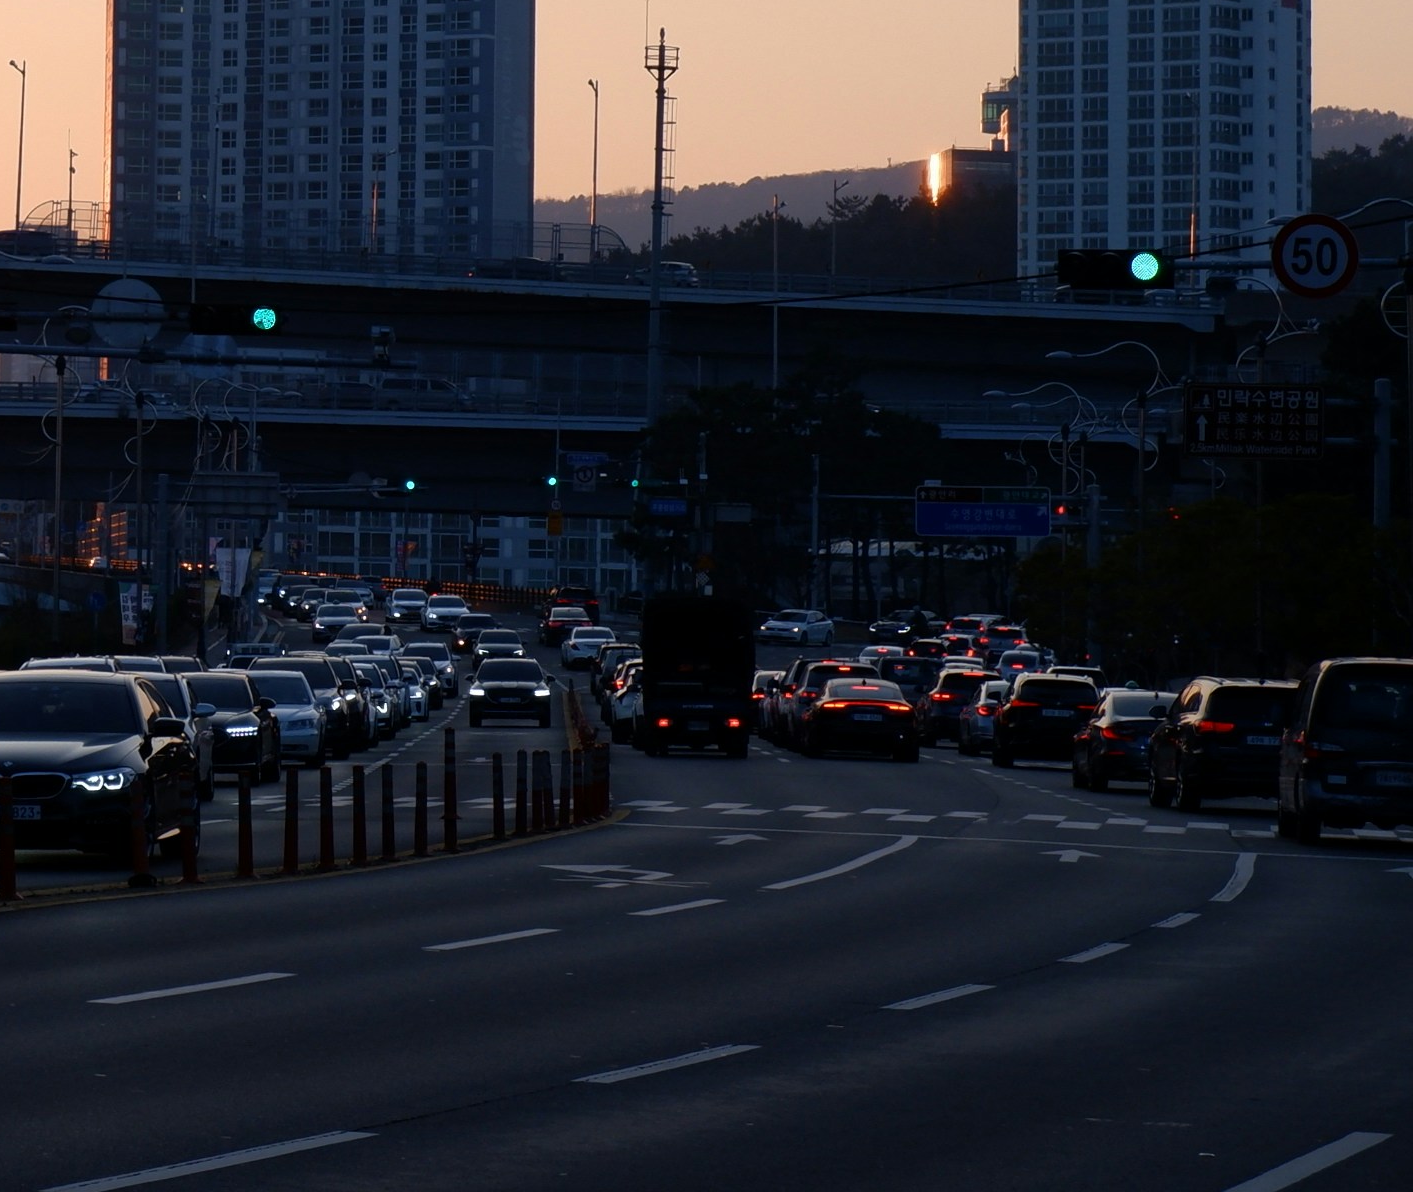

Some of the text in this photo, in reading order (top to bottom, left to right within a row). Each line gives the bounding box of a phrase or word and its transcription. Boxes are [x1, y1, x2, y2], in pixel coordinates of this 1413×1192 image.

[1291, 237, 1338, 276] 50
[1216, 388, 1320, 410] 민락수변공원
[1246, 444, 1293, 456] Waterside
[1295, 444, 1318, 456] Park
[950, 508, 1017, 521] 수영강변대로
